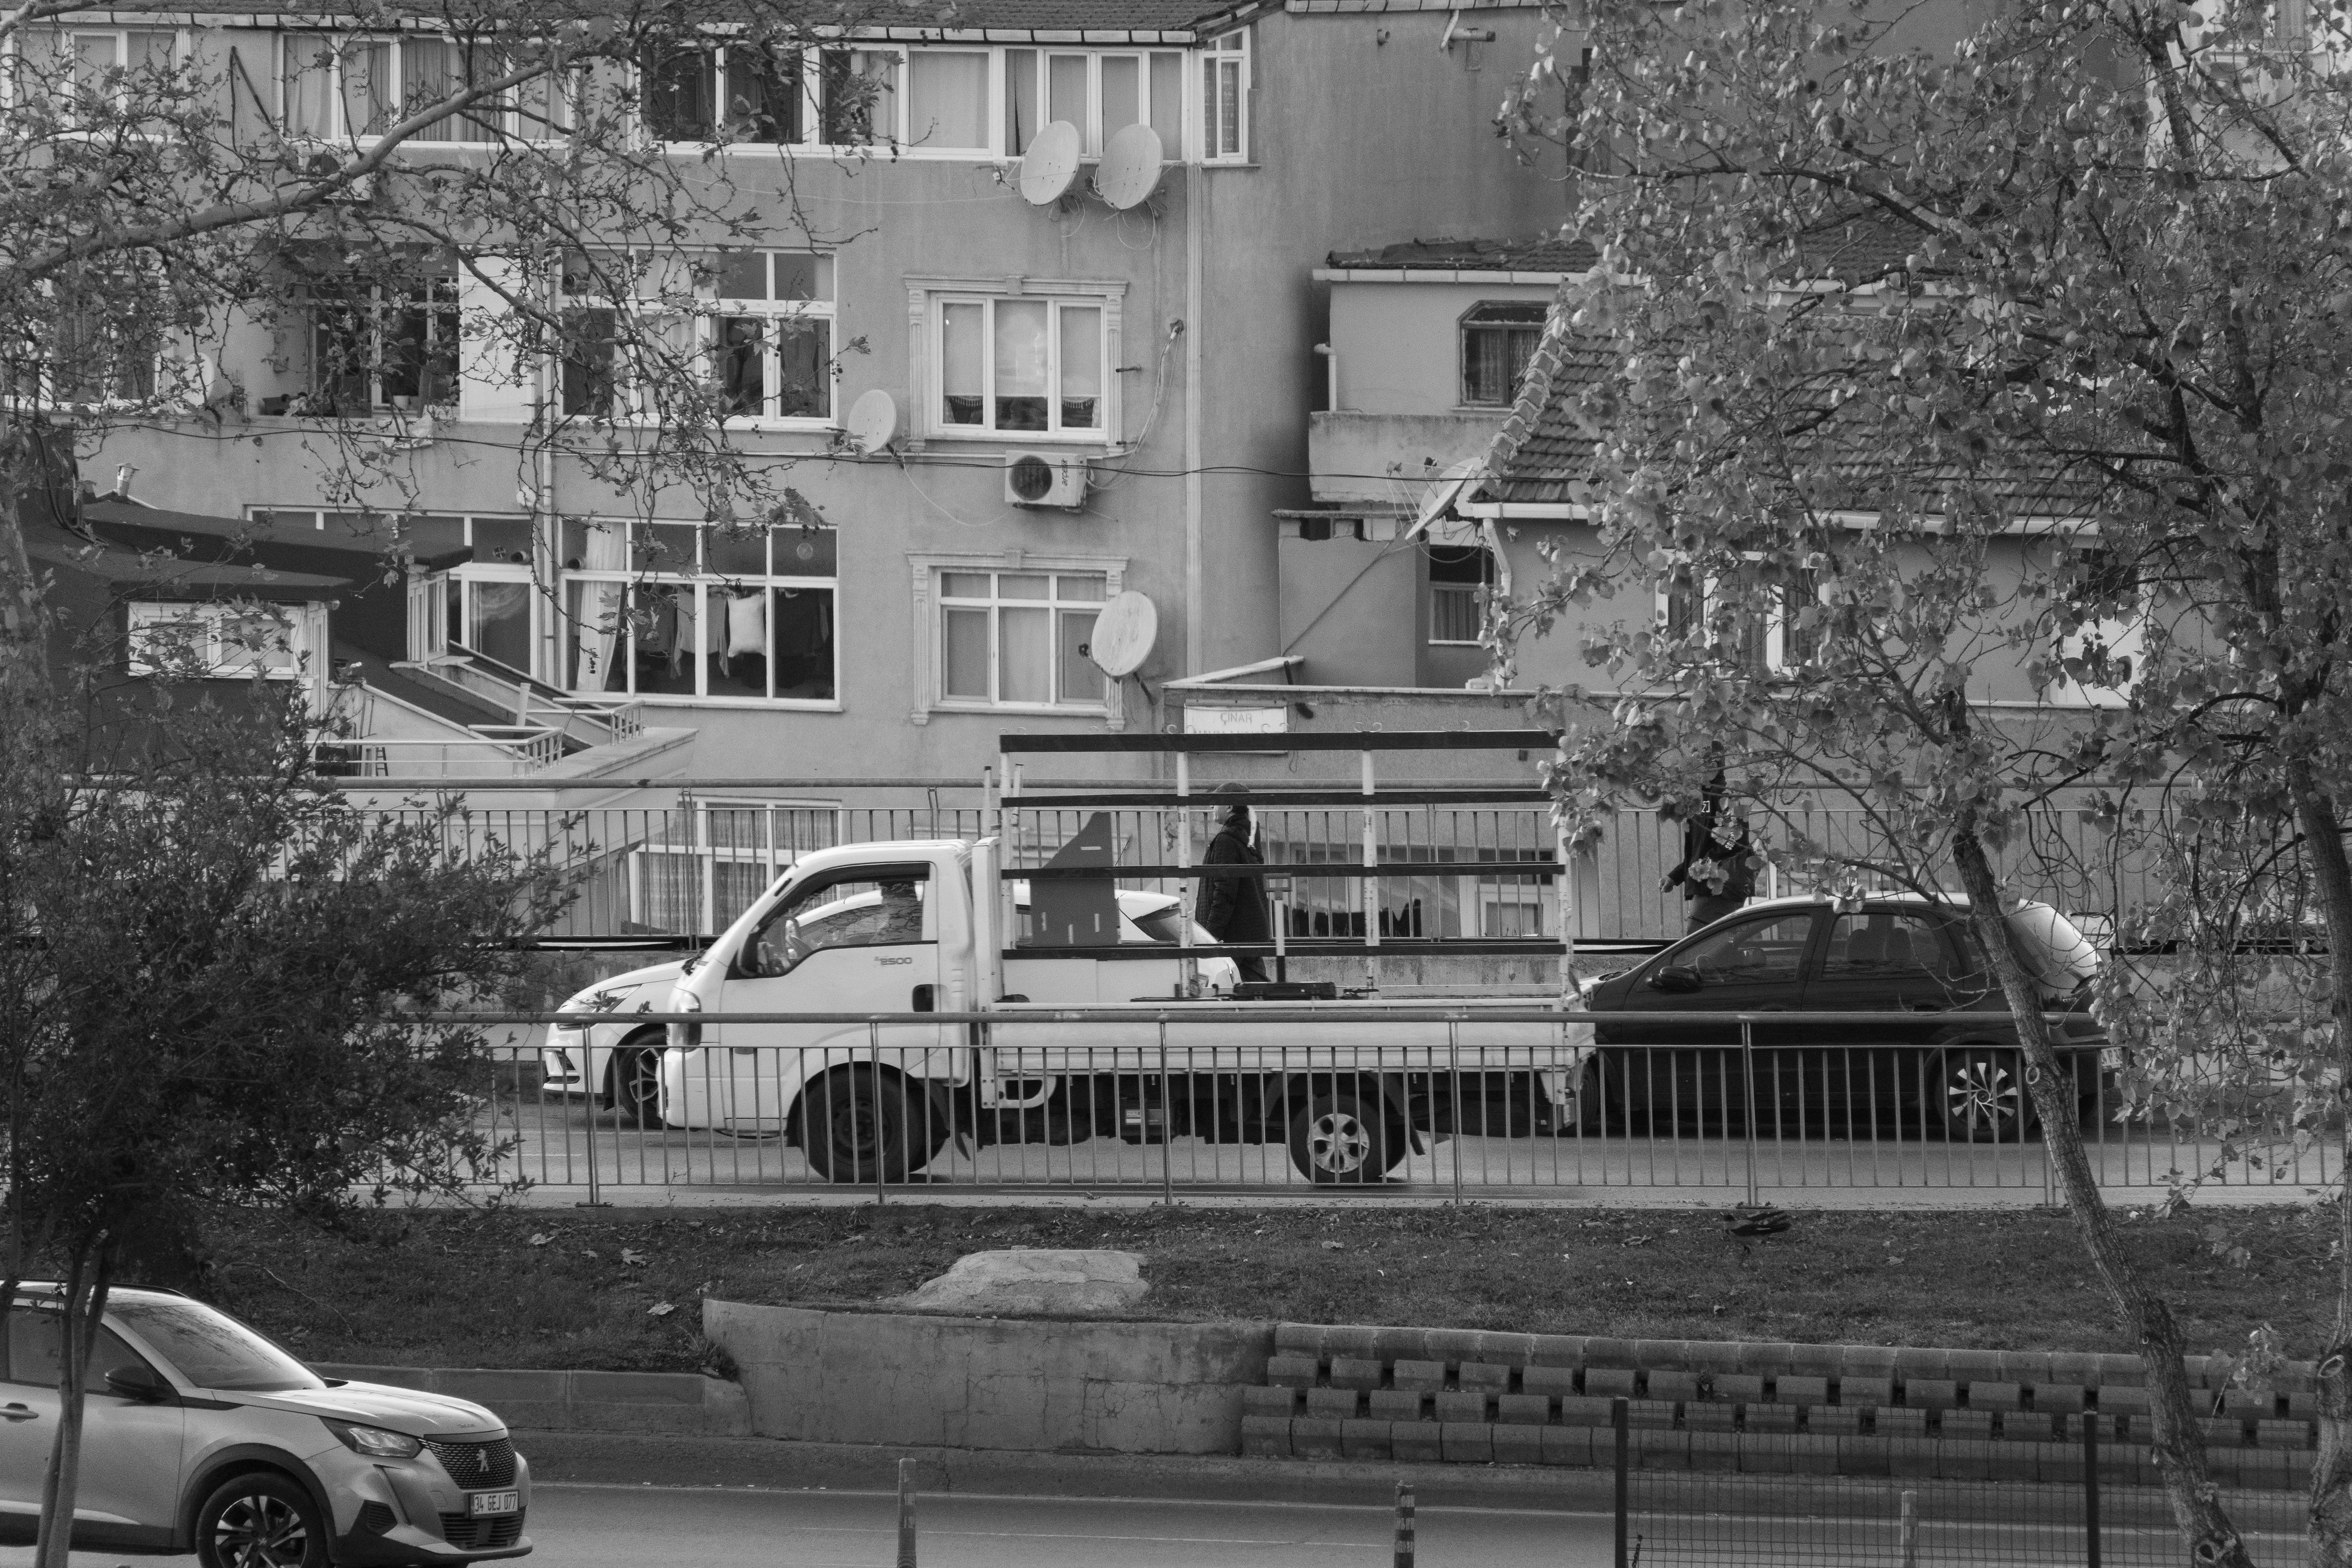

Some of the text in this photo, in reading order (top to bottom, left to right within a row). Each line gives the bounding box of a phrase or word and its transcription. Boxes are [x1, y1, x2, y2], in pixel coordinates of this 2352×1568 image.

[1220, 712, 1252, 725] ÇINAR
[475, 1493, 517, 1512] 34 GEJ 077
